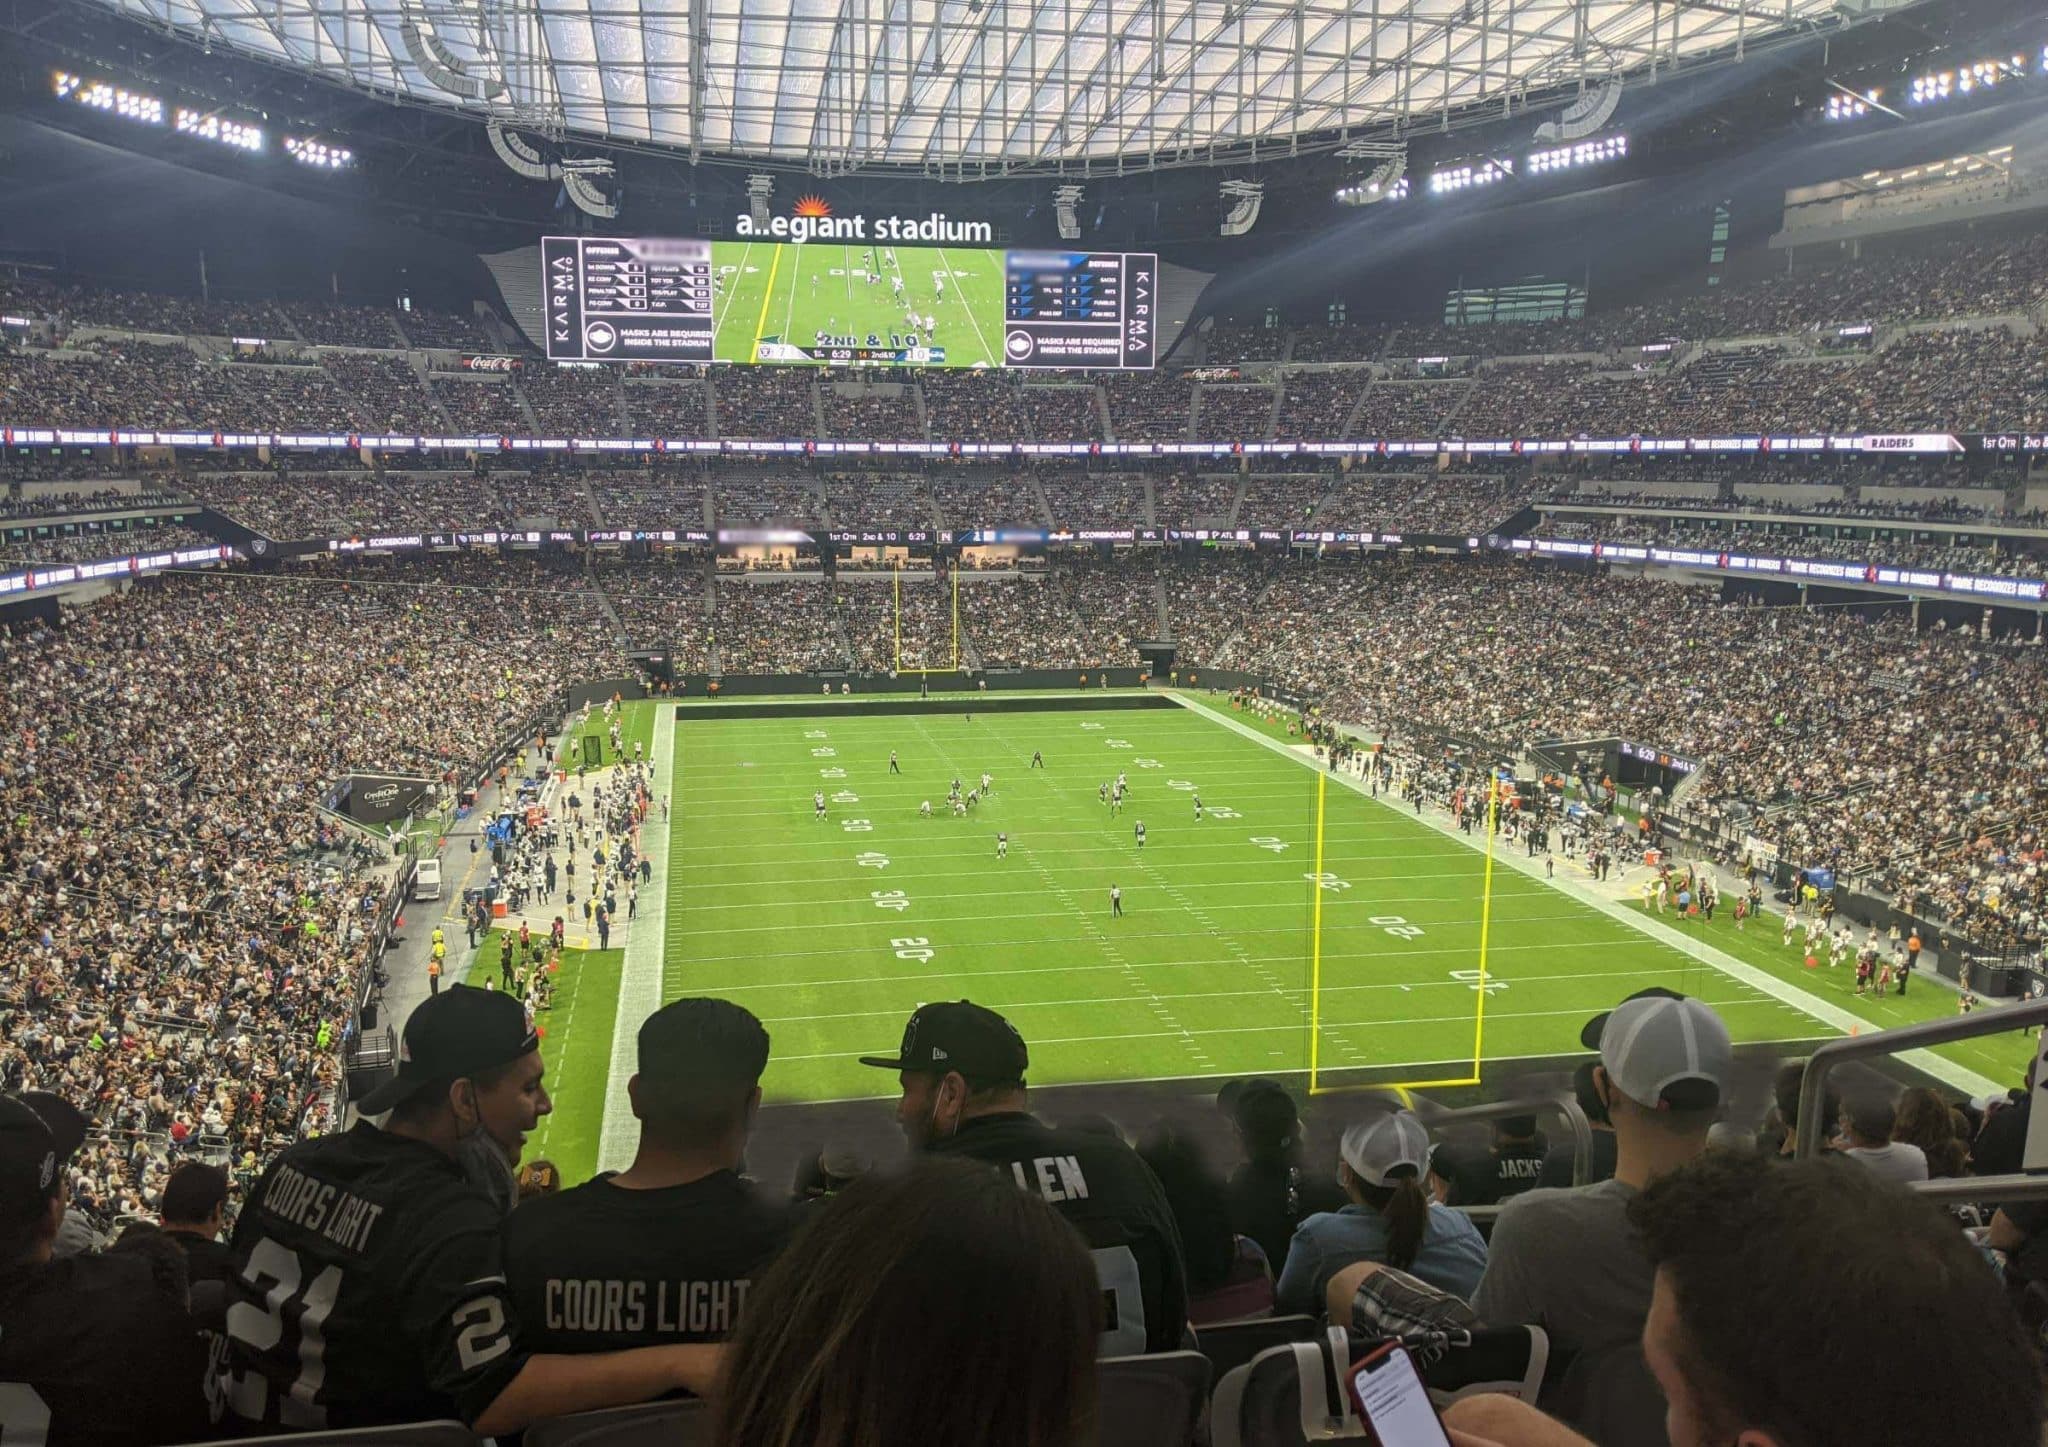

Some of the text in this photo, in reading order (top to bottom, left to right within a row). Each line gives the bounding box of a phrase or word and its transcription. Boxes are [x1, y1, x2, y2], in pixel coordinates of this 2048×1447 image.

[736, 211, 992, 243] aegiant stadium
[620, 329, 712, 338] MASKS ARE REQUIRED
[624, 338, 652, 346] INSIDE
[672, 339, 710, 347] STADIUM
[824, 334, 919, 347] 2ND & 10
[1037, 337, 1121, 347] MASKS ARE REQUIRED
[831, 350, 851, 359] 6:29
[1040, 346, 1067, 354] INSIDE
[1084, 347, 1118, 355] STADIUM
[1872, 437, 1915, 449] RAIDERS
[468, 534, 482, 542] TEN
[511, 533, 524, 542] ATL
[551, 533, 574, 541] FINAL
[602, 532, 617, 540] BUF
[645, 532, 661, 540] DET
[687, 532, 710, 540] FINAL
[886, 532, 897, 541] 10
[908, 532, 926, 541] 6:29
[1079, 531, 1132, 540] SCOREBOARD
[1143, 531, 1157, 539] NFL
[1180, 531, 1195, 539] TEN
[1220, 531, 1234, 539] ATL
[1260, 531, 1281, 540] FINAL
[1346, 533, 1360, 542] DET
[369, 537, 420, 547] SCOREBOARD
[431, 536, 445, 544] NFL
[264, 1163, 337, 1231] COORS
[546, 1279, 751, 1332] COORS LIGHT
[452, 1296, 511, 1372] 2
